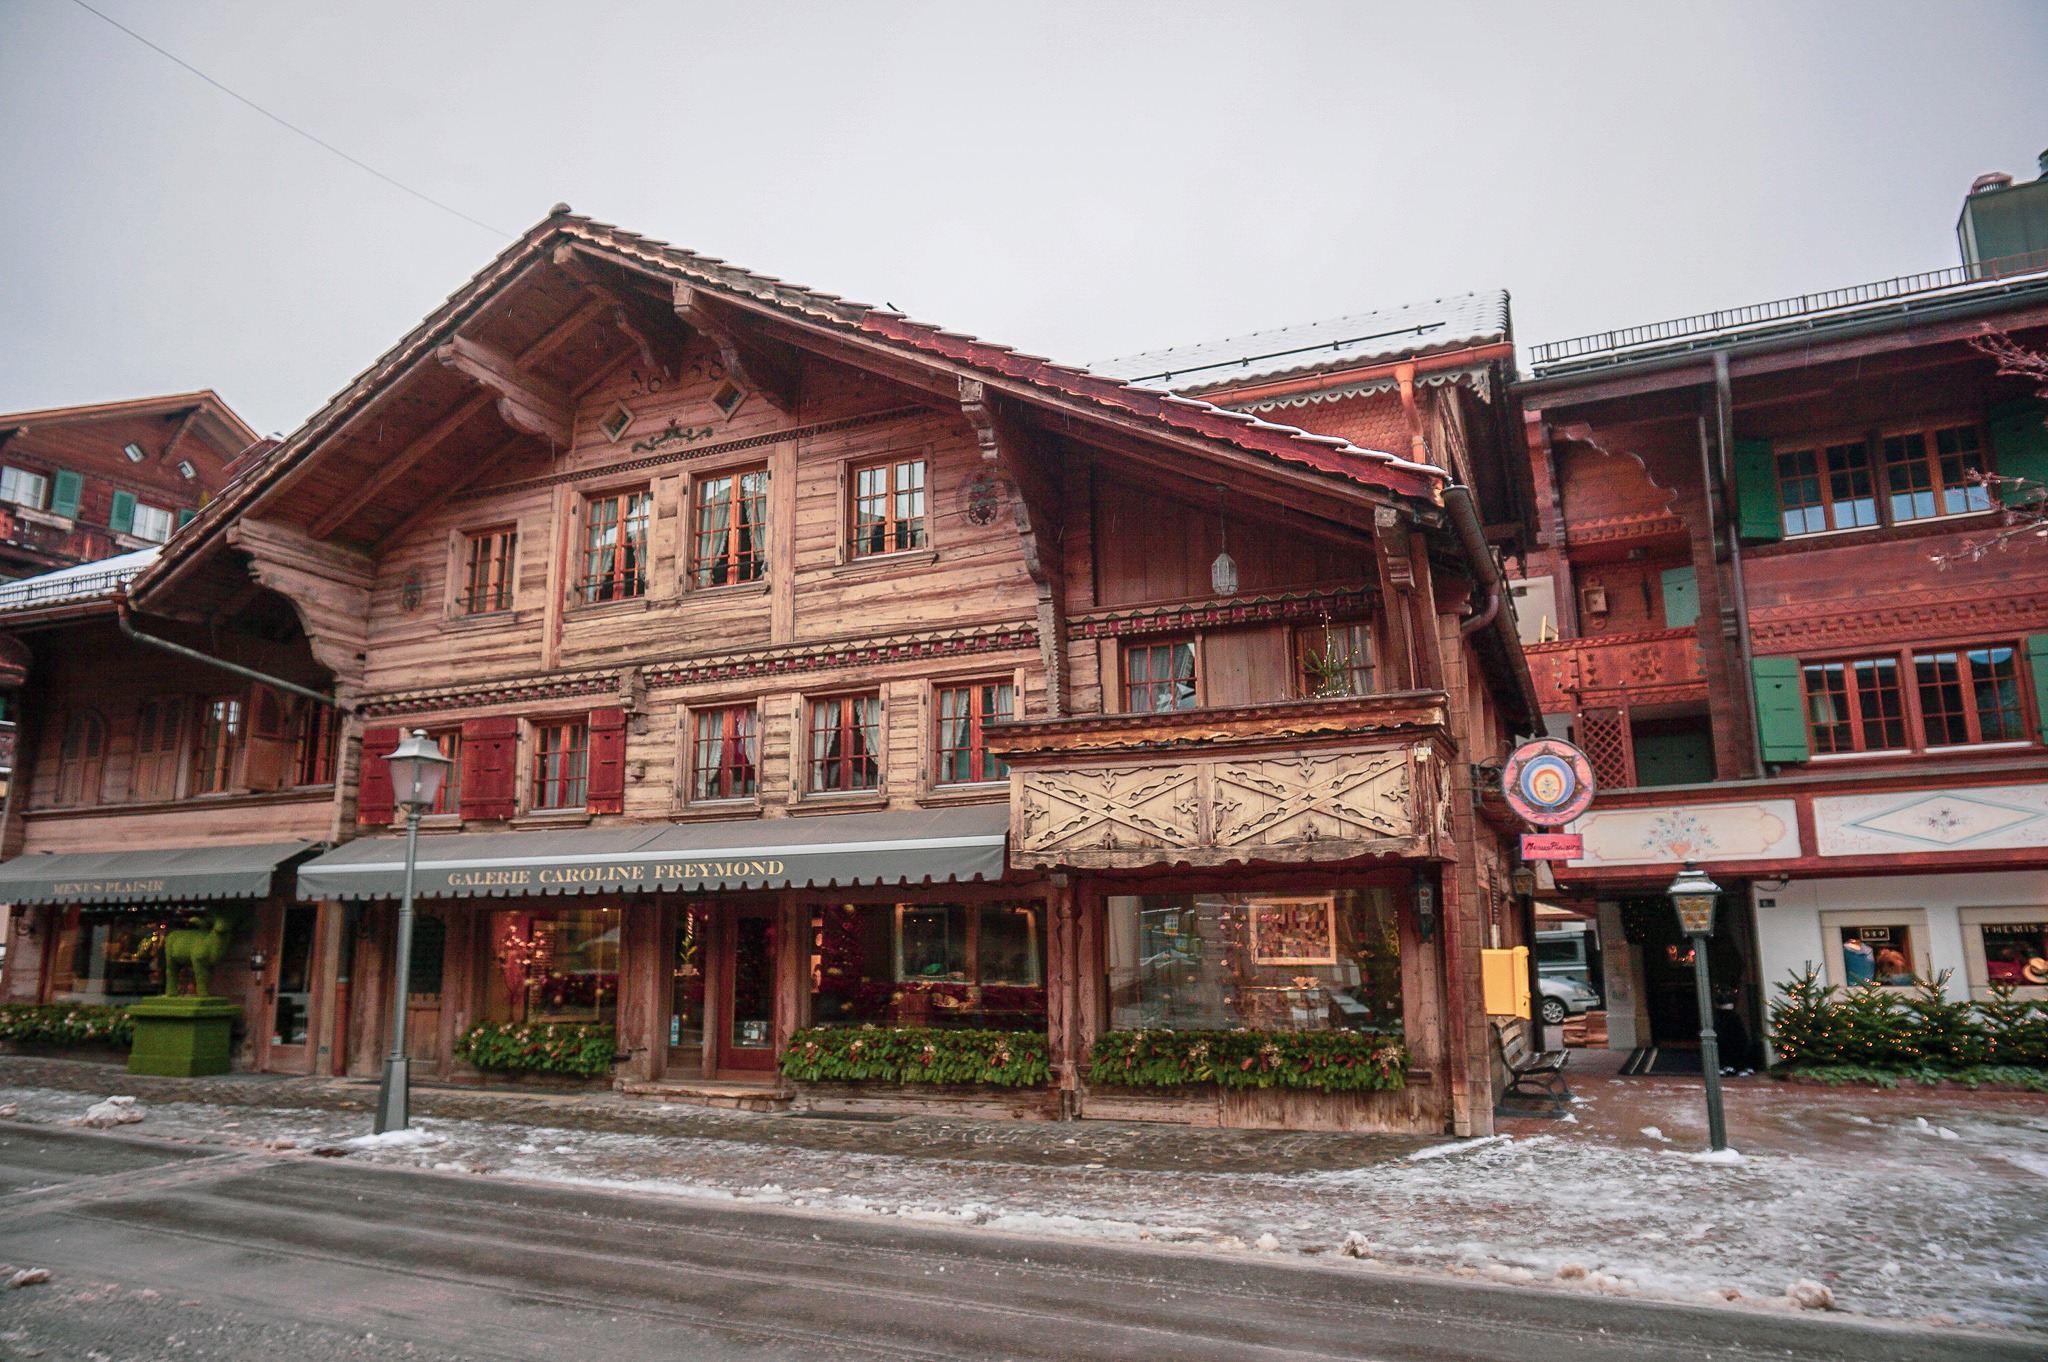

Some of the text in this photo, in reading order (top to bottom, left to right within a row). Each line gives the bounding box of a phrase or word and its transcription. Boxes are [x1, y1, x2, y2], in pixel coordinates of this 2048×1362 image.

[447, 860, 785, 886] GALERIE CAROLINE FREYMOND
